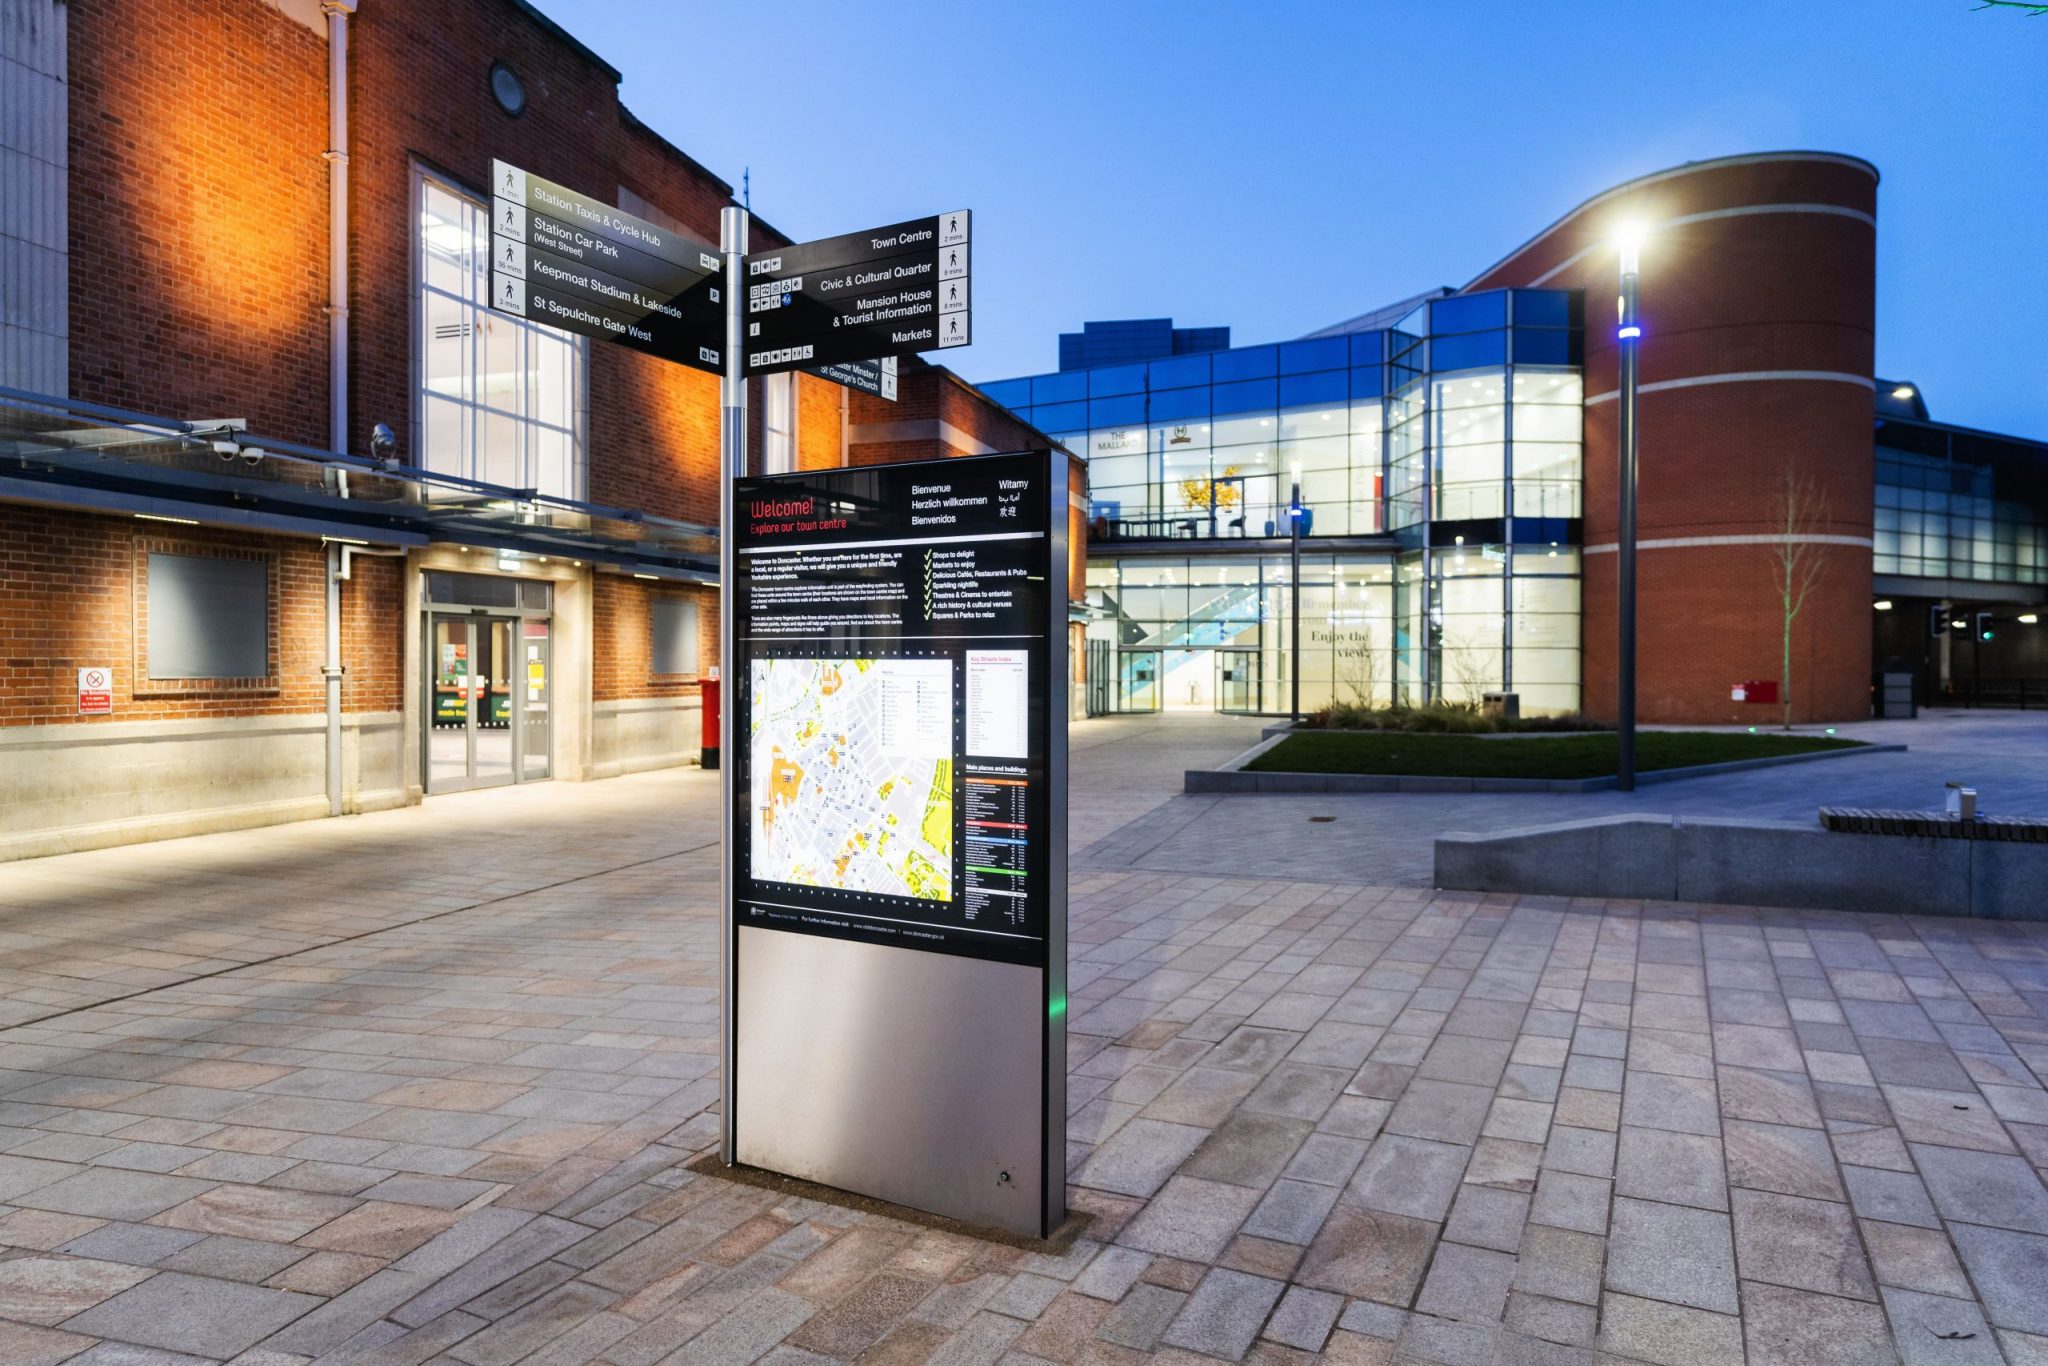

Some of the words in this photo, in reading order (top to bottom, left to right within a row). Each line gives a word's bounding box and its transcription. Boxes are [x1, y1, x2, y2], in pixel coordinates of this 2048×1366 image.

[507, 190, 519, 199] min
[534, 187, 572, 212] Station
[575, 203, 600, 223] Taxis
[603, 215, 610, 227] &
[613, 219, 639, 238] Cycle
[642, 230, 661, 247] Hub
[505, 226, 520, 237] mins
[534, 217, 572, 241] Station
[575, 233, 593, 248] Car
[596, 241, 619, 258] Park
[534, 233, 556, 248] (West
[558, 242, 583, 259] Street)
[872, 238, 897, 249] Town
[899, 230, 932, 244] Centre
[507, 264, 522, 275] mins
[820, 278, 843, 291] Civic
[846, 276, 852, 287] &
[855, 269, 891, 285] Cultural
[894, 263, 932, 278] Quarter
[534, 260, 588, 287] Keepmoat
[591, 279, 631, 302] Stadium
[633, 293, 640, 305] &
[642, 297, 682, 318] Lakeside
[505, 300, 520, 310] mins
[857, 295, 897, 310] Mansion
[900, 290, 932, 303] House
[534, 296, 546, 310] St
[549, 300, 600, 326] Sepulchre
[603, 317, 626, 334] Gate
[628, 324, 652, 341] West
[833, 317, 840, 327] &
[842, 312, 873, 326] Tourist
[876, 303, 932, 320] Information
[892, 328, 932, 343] Markets
[821, 365, 828, 374] St
[857, 377, 878, 391] Church
[853, 364, 874, 380] Minster
[1110, 432, 1125, 440] THE
[911, 484, 951, 495] Bienvenue
[998, 480, 1029, 490] Witamy
[751, 496, 813, 518] Welcome!
[911, 498, 941, 509] Herzlich
[943, 496, 987, 507] willkommen
[1000, 506, 1016, 518] 欢迎
[911, 514, 956, 525] Bienvenidos
[750, 523, 779, 536] Explore
[781, 523, 795, 532] our
[796, 520, 817, 531] town
[819, 519, 847, 529] centre
[956, 550, 975, 558] delight
[961, 561, 975, 569] enjoy
[974, 569, 1007, 577] Restaurants
[932, 581, 956, 589] Sparkling
[957, 581, 978, 589] nightlife
[948, 601, 966, 610] history
[1311, 630, 1345, 643] Enjoy
[1349, 631, 1369, 641] the
